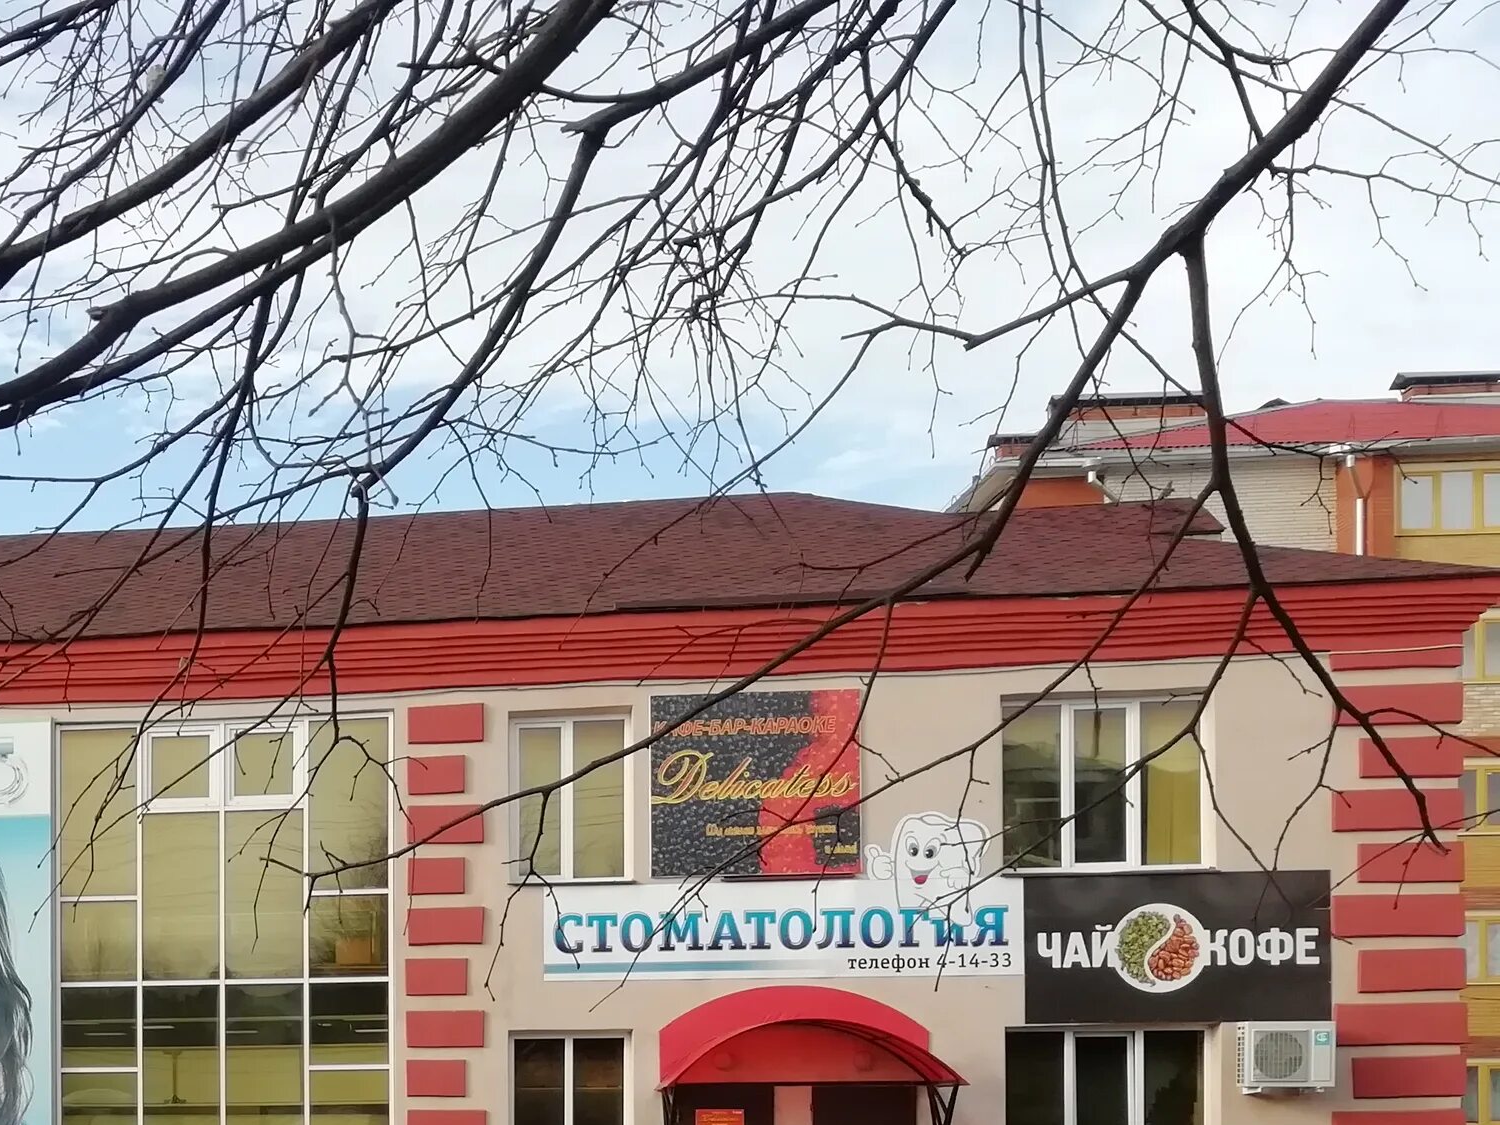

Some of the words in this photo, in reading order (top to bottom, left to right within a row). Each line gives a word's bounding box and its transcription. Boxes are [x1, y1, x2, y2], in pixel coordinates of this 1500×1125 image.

[654, 715, 837, 738] КФЕ-БАР-КАРАОКЕ
[651, 749, 859, 805] Delicatess
[848, 953, 930, 973] телефон
[936, 952, 1013, 969] 4-14-33
[1036, 924, 1116, 969] ЧАЙ
[1203, 927, 1321, 966] КОФЕ
